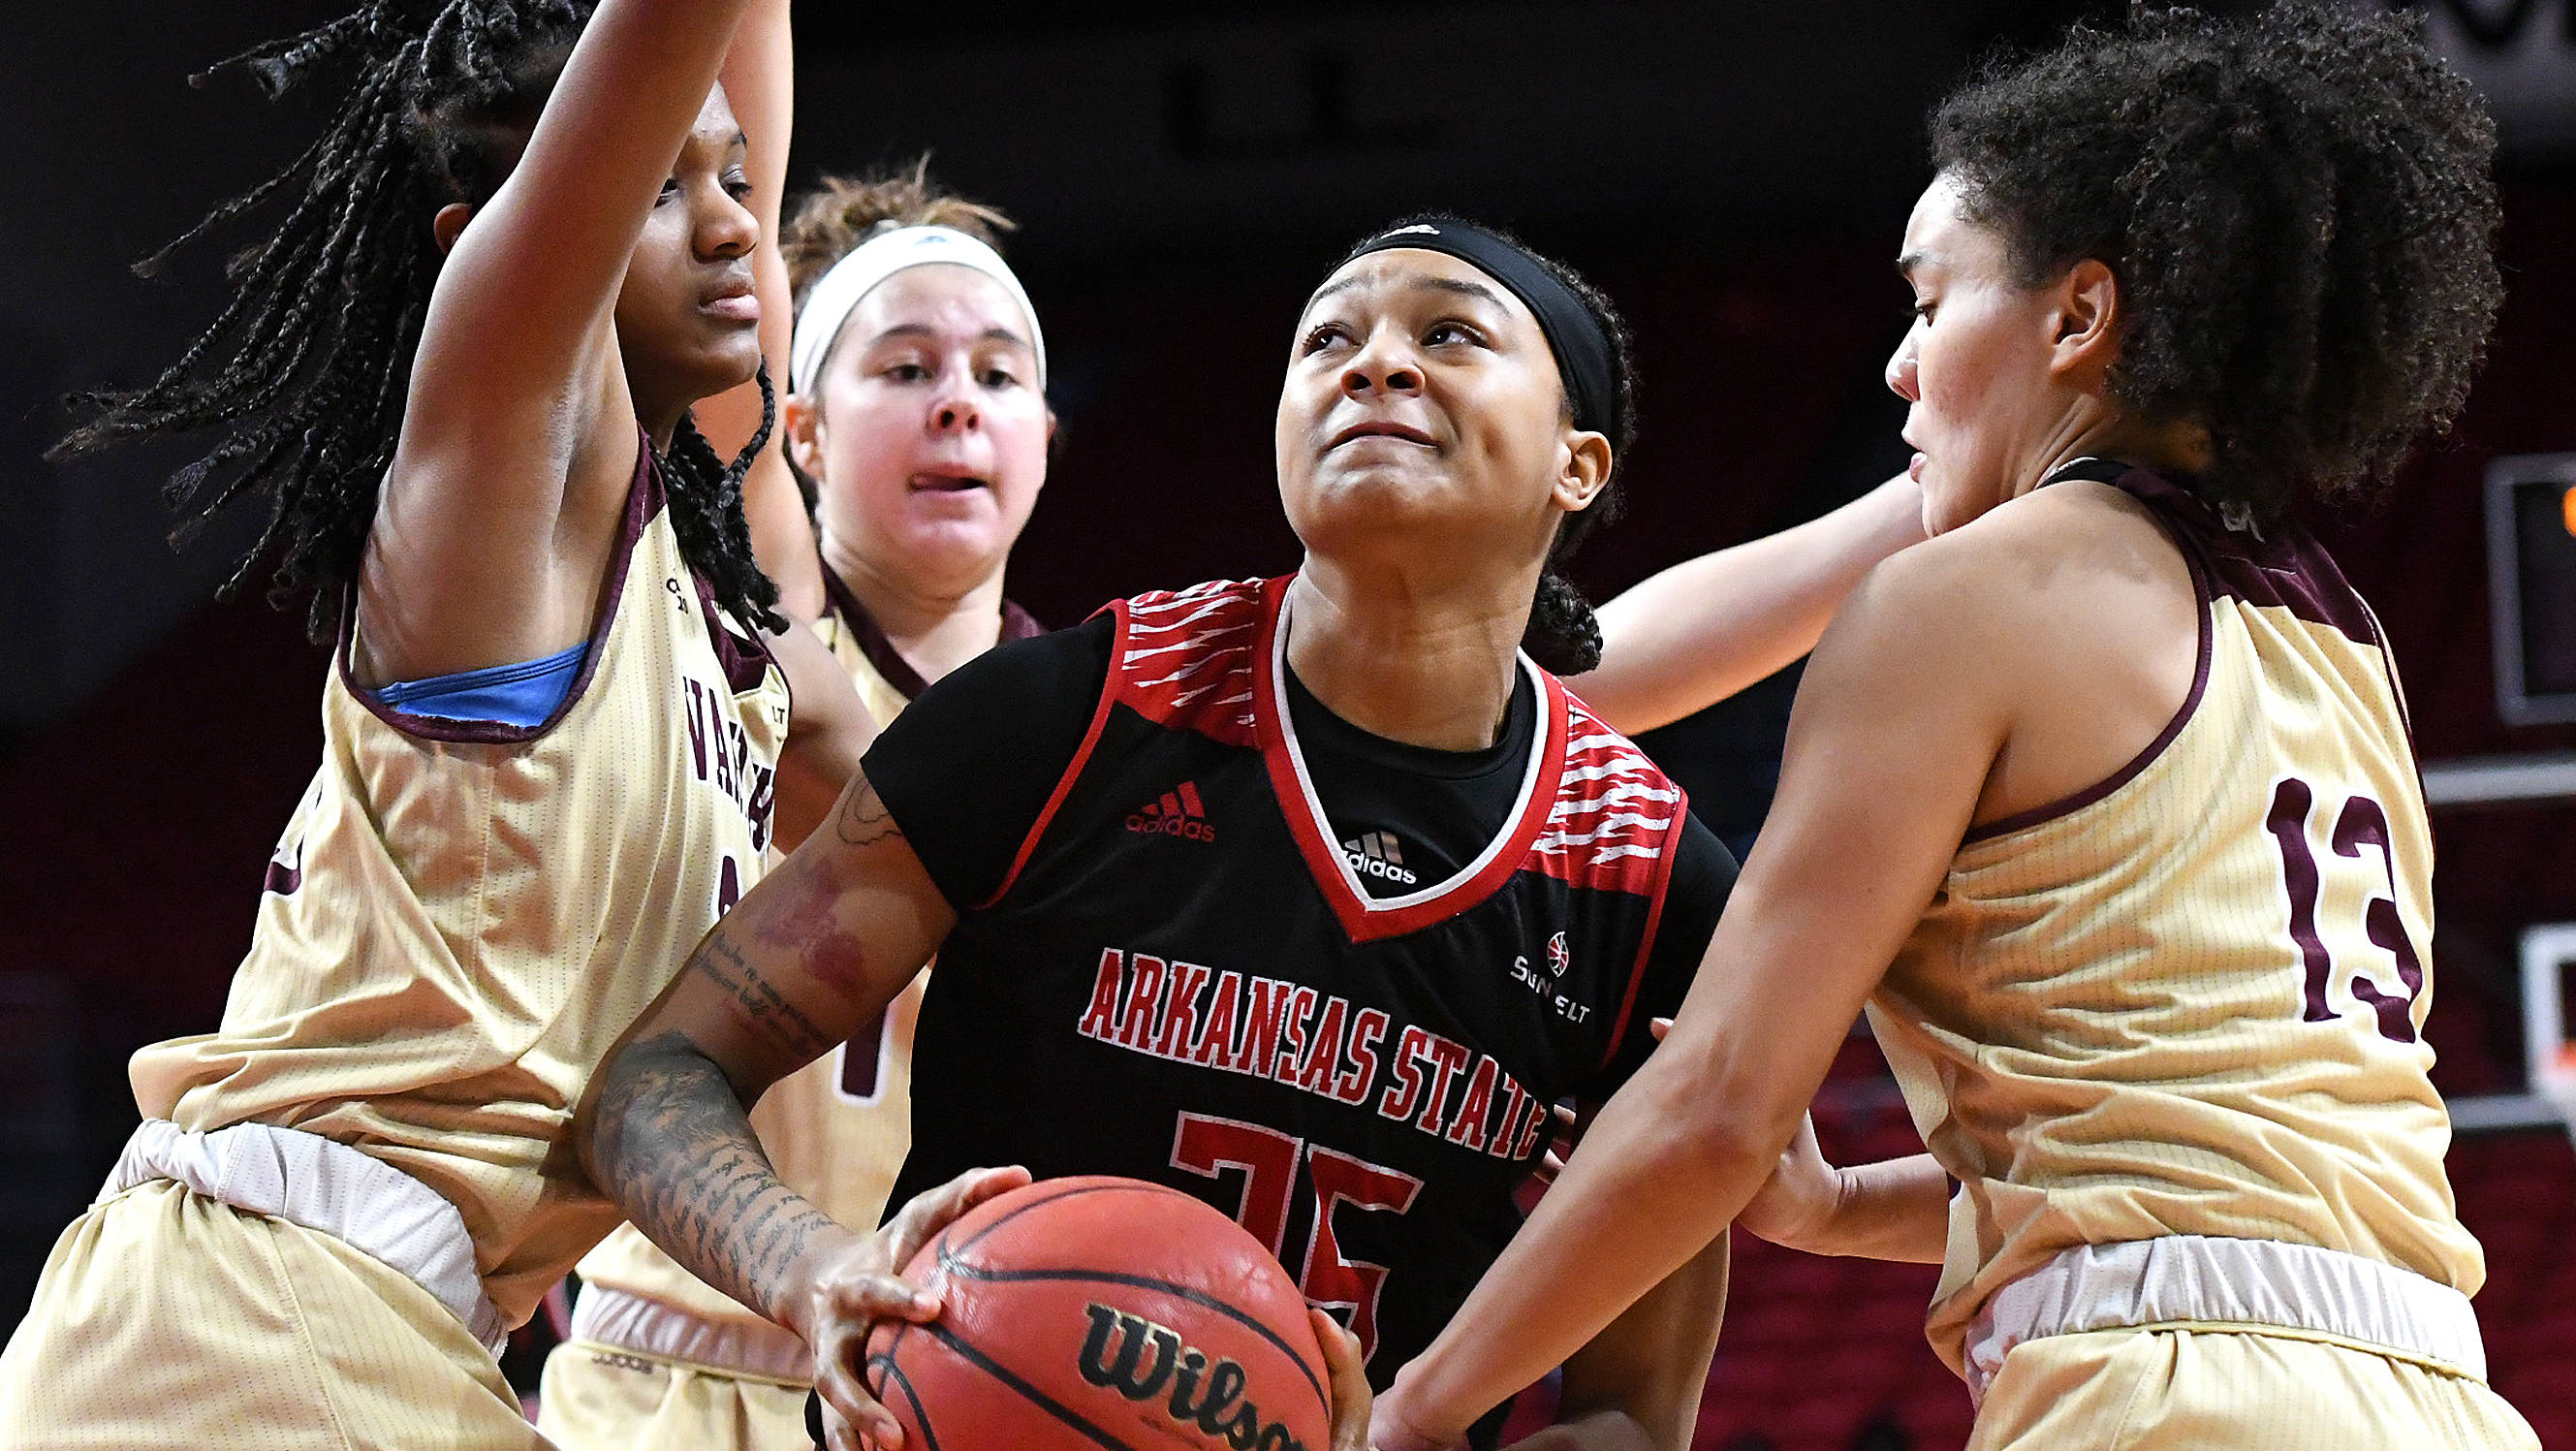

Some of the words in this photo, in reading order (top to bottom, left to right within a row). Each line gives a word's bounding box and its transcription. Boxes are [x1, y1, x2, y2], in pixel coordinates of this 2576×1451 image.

[1124, 812, 1216, 842] adidas
[1342, 849, 1417, 885] didas
[2262, 773, 2424, 1046] 13
[1078, 947, 1392, 1106] ARKANSAS
[1377, 1025, 1547, 1161] STATE
[1553, 994, 1590, 1024] ELT
[1077, 1302, 1304, 1451] Wilso
